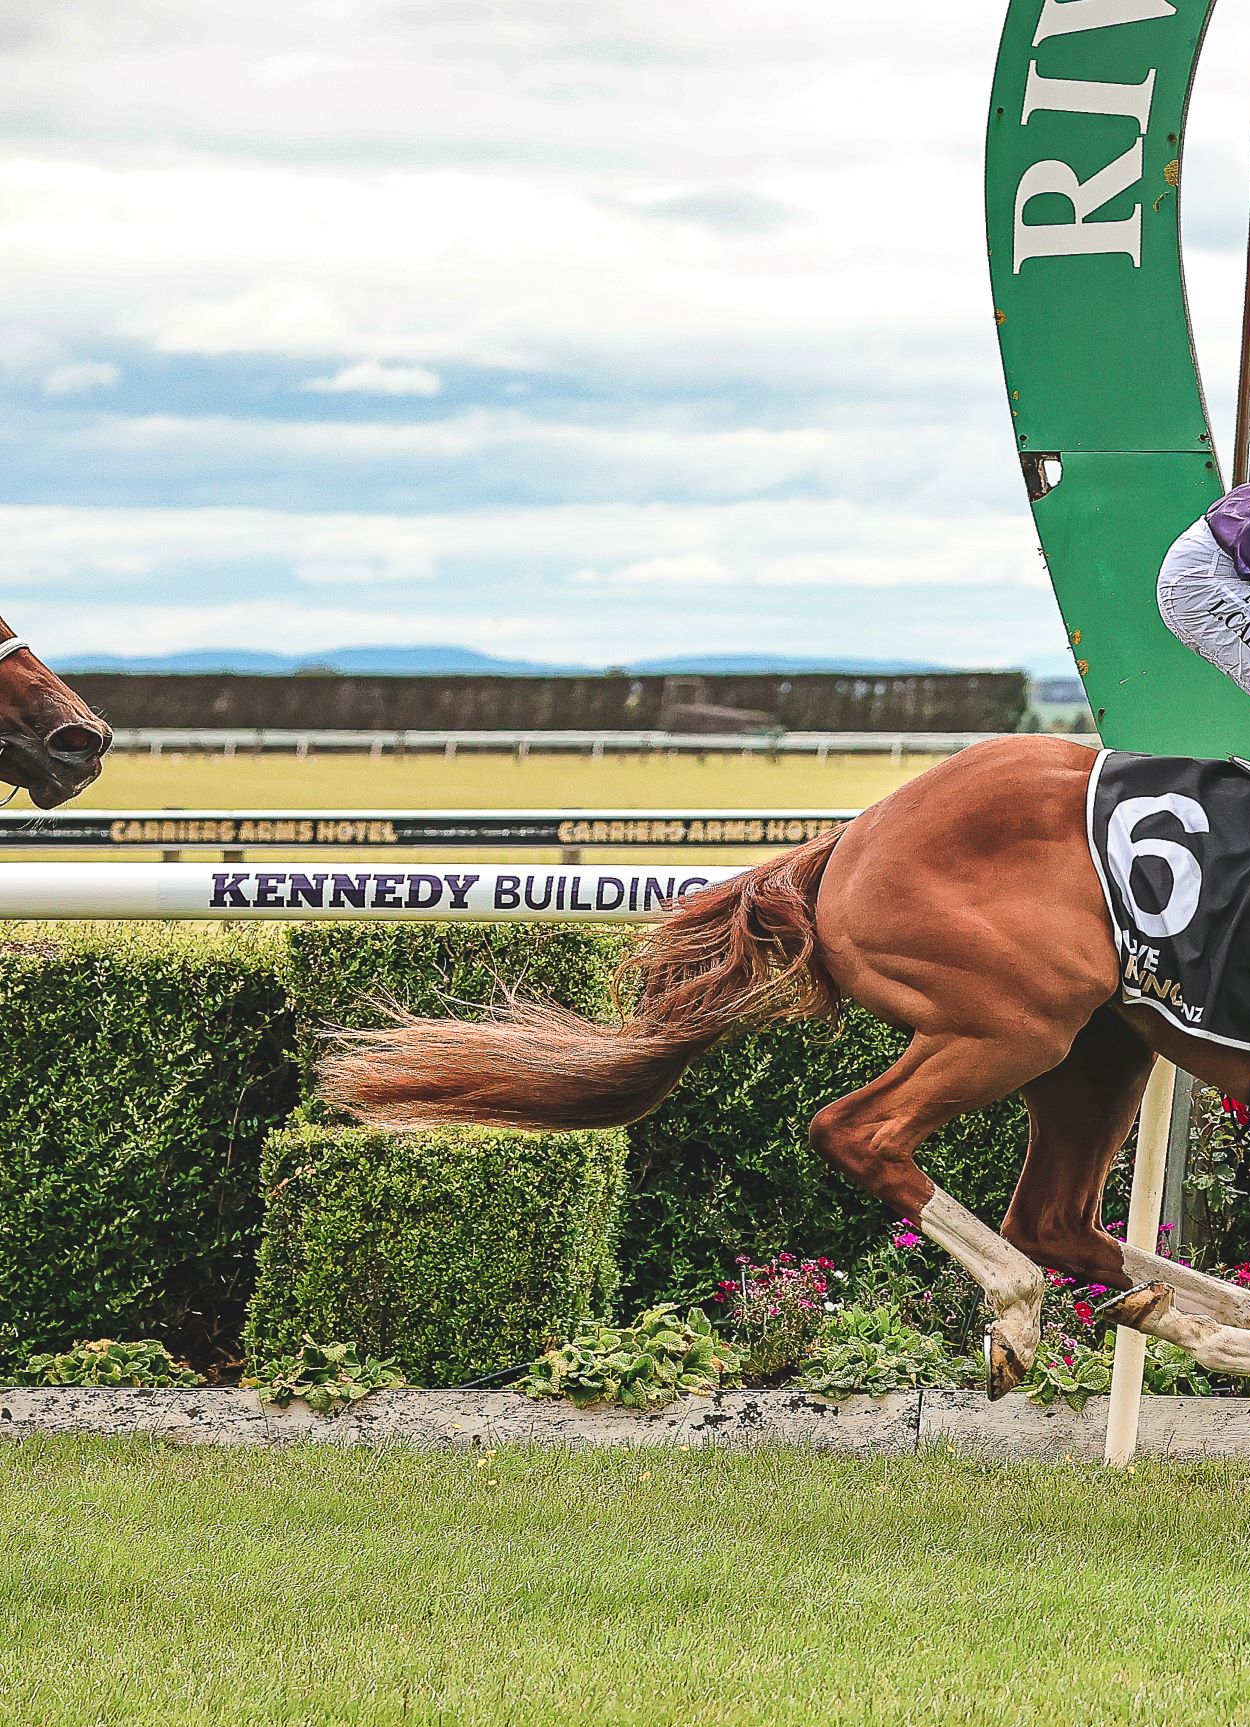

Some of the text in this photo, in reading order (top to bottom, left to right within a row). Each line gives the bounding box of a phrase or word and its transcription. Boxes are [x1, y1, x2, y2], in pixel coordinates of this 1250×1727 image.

[239, 820, 314, 842] ARMS
[316, 820, 398, 842] HOTEL
[766, 819, 842, 841] HOTE
[1107, 792, 1209, 938] 6
[208, 873, 479, 908] KENNEDY
